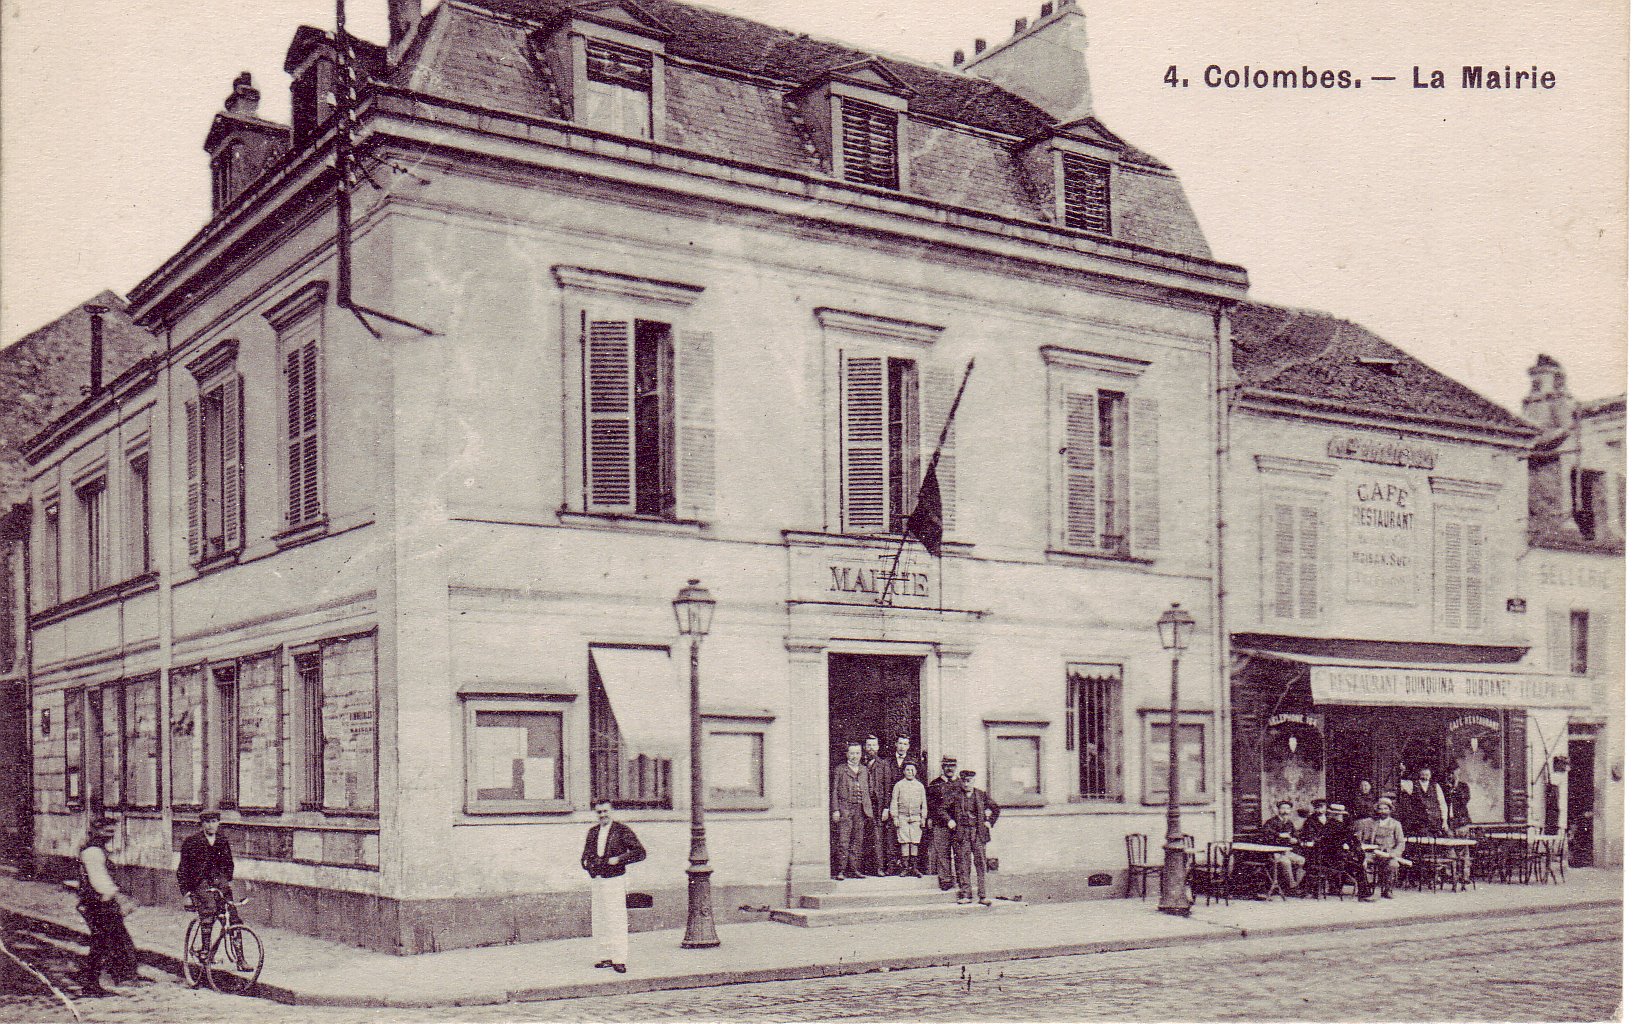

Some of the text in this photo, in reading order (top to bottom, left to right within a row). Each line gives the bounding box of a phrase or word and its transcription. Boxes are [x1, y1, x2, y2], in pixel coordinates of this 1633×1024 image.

[1352, 506, 1414, 530] RESTAURANT
[829, 566, 929, 597] MAIRIE
[1405, 674, 1454, 695] QUINQUINA
